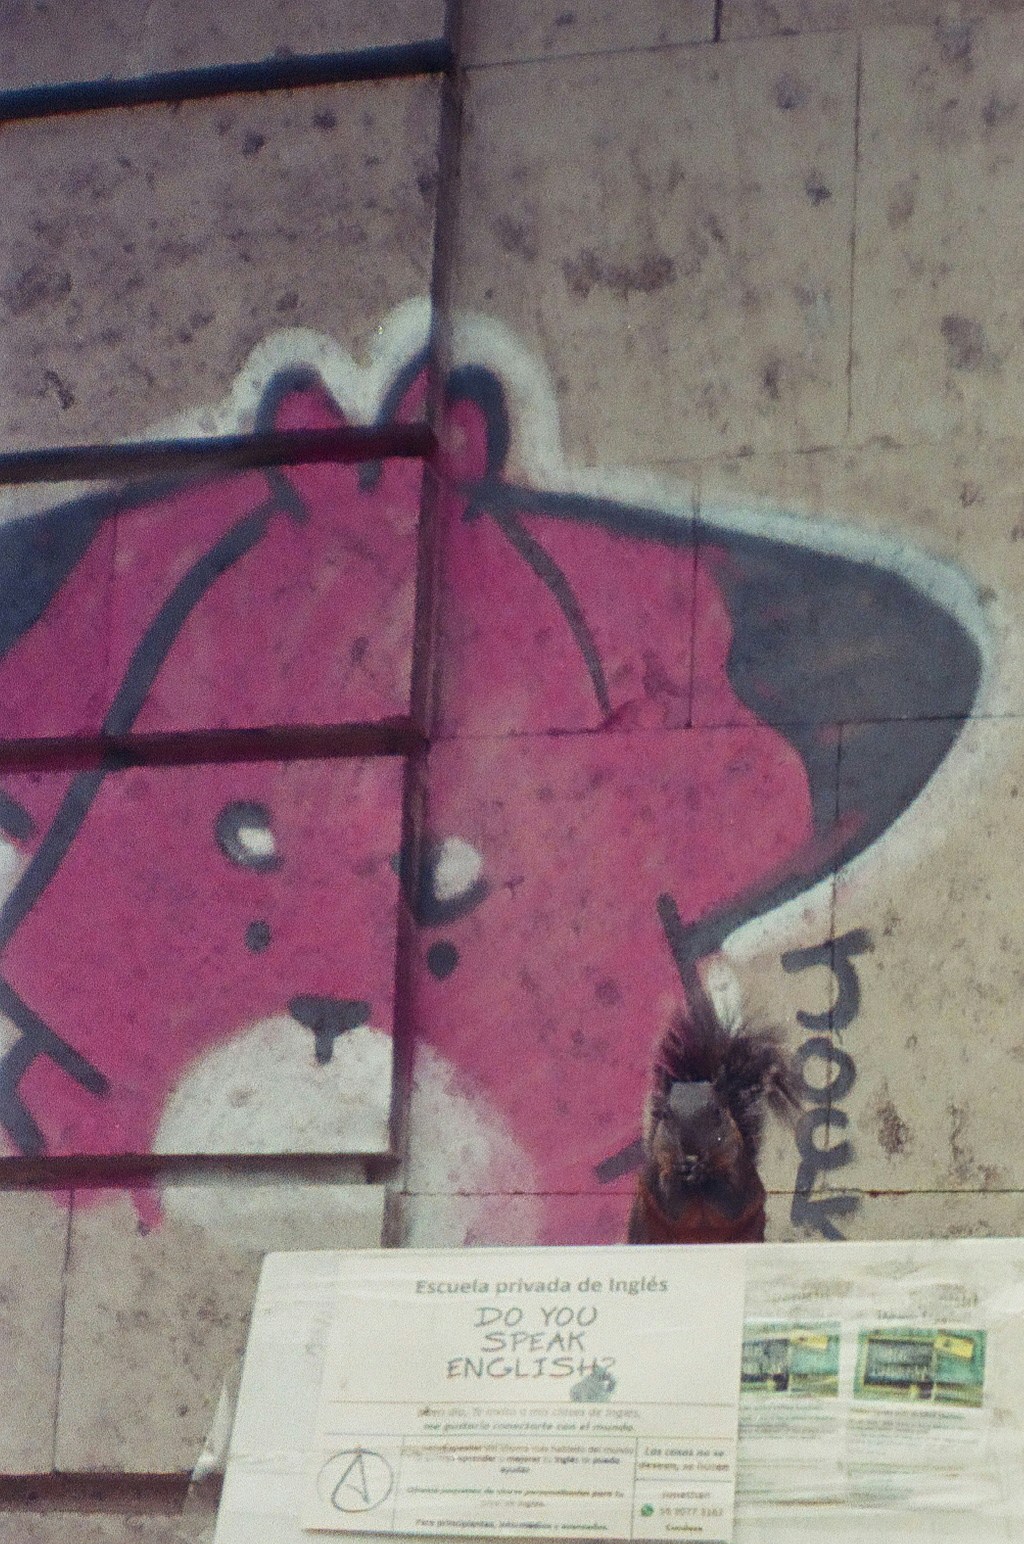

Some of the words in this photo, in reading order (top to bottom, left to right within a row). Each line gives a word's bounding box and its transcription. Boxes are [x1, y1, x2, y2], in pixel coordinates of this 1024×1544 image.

[415, 1279, 489, 1295] Escuela
[496, 1277, 571, 1297] privada
[577, 1277, 603, 1293] de
[609, 1276, 668, 1296] Inglés
[474, 1306, 523, 1328] DO
[541, 1306, 598, 1327] YOU
[481, 1331, 585, 1352] SPEAK
